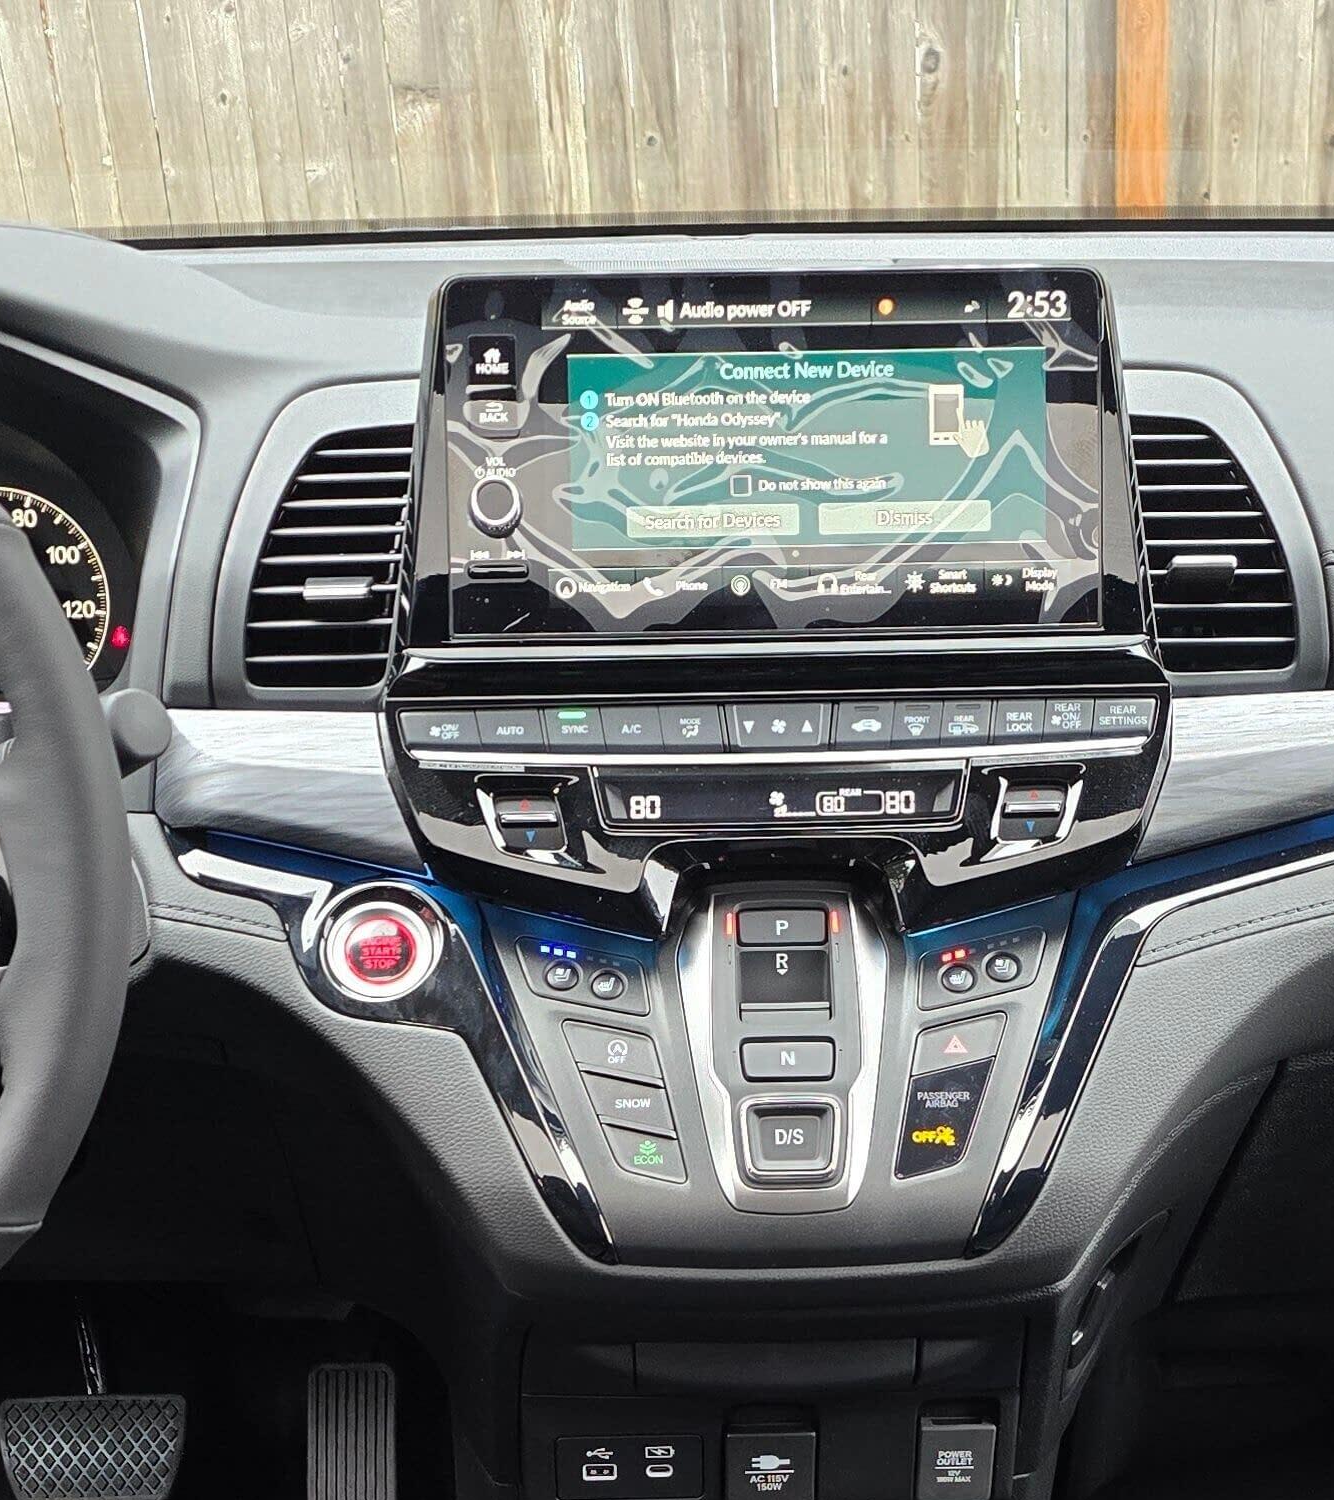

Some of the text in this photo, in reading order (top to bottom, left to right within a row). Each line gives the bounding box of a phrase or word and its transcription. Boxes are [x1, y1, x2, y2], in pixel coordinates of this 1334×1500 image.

[564, 299, 595, 312] Audio
[1007, 290, 1067, 318] 2:53
[680, 300, 812, 321] Audio power OFF
[475, 362, 509, 375] HOME
[720, 361, 895, 380] Connect New Device
[605, 390, 811, 407] Turn ON Bluetooth on the device
[479, 411, 508, 423] BACK
[605, 414, 669, 428] Search for
[606, 431, 888, 449] Visit the website in your owner's manual for a
[485, 456, 506, 467] VOL
[606, 451, 766, 467] list of compatible devices.
[486, 467, 516, 478] AUDIO
[758, 477, 886, 491] Do not show this again
[12, 509, 38, 528] 80
[645, 513, 781, 530] Search for Devices
[875, 509, 933, 526] Dismiss
[46, 546, 81, 564] 100
[1021, 567, 1059, 580] Display
[675, 581, 708, 592] Phone
[1025, 579, 1055, 592] Mode
[62, 600, 96, 619] 120
[1054, 702, 1081, 712] REAR
[1109, 705, 1136, 715] REAR
[680, 717, 701, 725] MODE
[904, 715, 930, 724] FRONT
[953, 714, 975, 723] REAR
[1006, 711, 1033, 722] REAR
[1062, 711, 1081, 722] ON/
[1098, 714, 1148, 726] SETTINGS
[561, 724, 589, 735] SYNC
[621, 724, 642, 735] A/C
[1006, 721, 1034, 732] LOCK
[1062, 720, 1082, 730] OFF
[441, 731, 461, 741] OFF
[496, 726, 524, 736] AUTO
[629, 795, 661, 819] 80
[822, 796, 845, 812] 80
[885, 790, 915, 814] 80
[775, 919, 789, 936] P
[364, 959, 397, 969] STOP
[775, 952, 789, 969] R
[608, 1056, 627, 1064] OFF
[780, 1051, 796, 1066] N
[917, 1091, 970, 1101] PASSENGER
[615, 1098, 651, 1108] SNOW
[925, 1100, 959, 1109] AIRBAG
[774, 1128, 805, 1145] D/S
[633, 1155, 663, 1165] ECON
[938, 1450, 972, 1458] POWER
[937, 1457, 974, 1465] OUTLET
[750, 1474, 790, 1483] AC 115V
[757, 1482, 783, 1491] 150W
